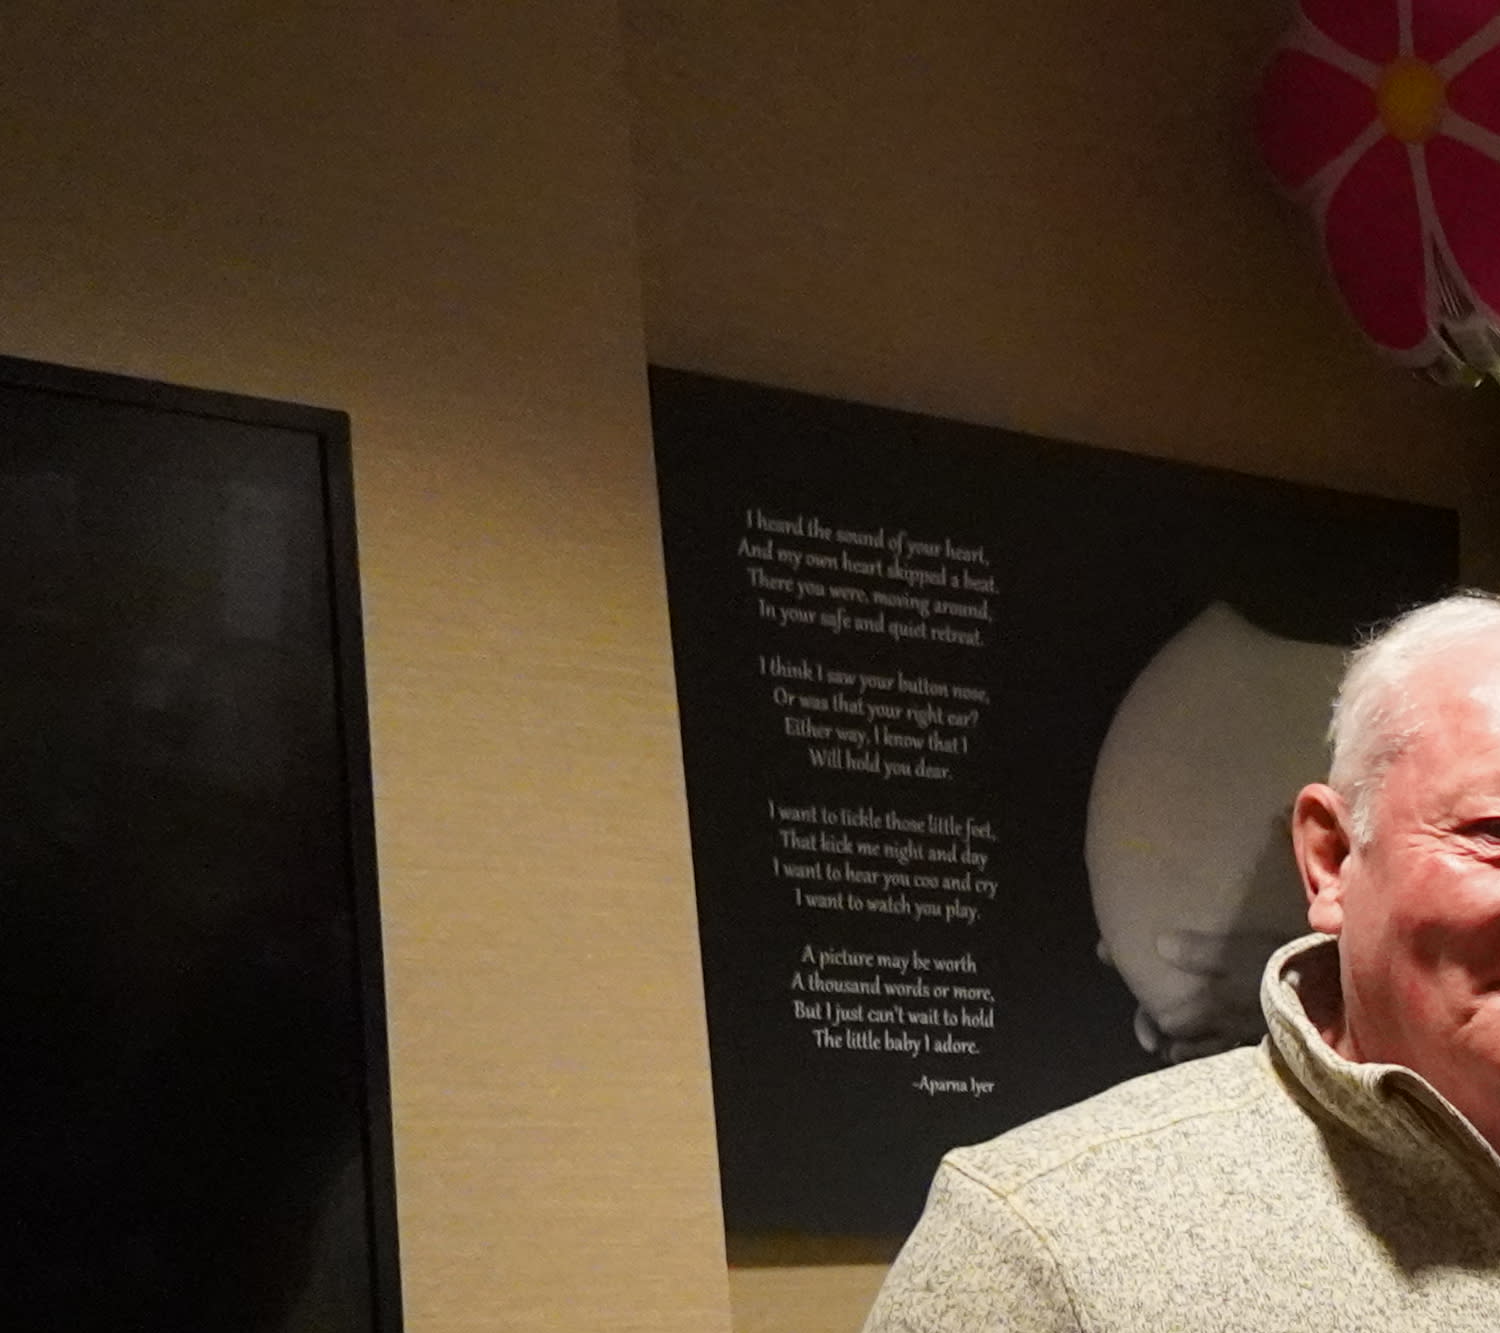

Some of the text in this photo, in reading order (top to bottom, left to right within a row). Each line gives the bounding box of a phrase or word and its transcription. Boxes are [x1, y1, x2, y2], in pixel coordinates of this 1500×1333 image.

[773, 687, 978, 728] Or was that your right ear?
[785, 717, 832, 738] Either
[836, 728, 870, 749] way,
[884, 725, 924, 749] know
[929, 730, 958, 752] that
[808, 749, 953, 779] Will hold you dear.
[778, 807, 816, 823] want
[822, 807, 837, 825] to
[841, 808, 882, 829] tickle
[886, 811, 925, 832] those
[928, 814, 962, 836] little
[966, 818, 999, 842] feet,
[779, 829, 817, 848] That
[820, 832, 852, 853] kick
[857, 843, 880, 856] me
[884, 839, 923, 865] night
[928, 844, 957, 863] and
[783, 861, 821, 880] want
[826, 863, 841, 881] to
[845, 861, 878, 884] hear
[883, 873, 910, 891] you
[914, 875, 939, 888] coo
[943, 872, 970, 891] and
[975, 879, 998, 899] cry
[804, 892, 843, 909] want
[848, 895, 863, 911] to
[866, 894, 911, 913] watch
[915, 904, 941, 921] you
[945, 899, 981, 924] play.
[820, 949, 873, 969] picture
[877, 955, 910, 975] may
[913, 950, 930, 970] be
[934, 953, 976, 973] worth
[808, 970, 880, 994] thousand
[884, 977, 929, 997] words
[933, 986, 950, 998] or
[953, 986, 995, 1002] more,
[794, 1001, 821, 1019] But
[832, 1004, 864, 1026] just
[868, 1006, 904, 1023] can't
[908, 1008, 939, 1025] wait
[943, 1007, 958, 1025] to
[962, 1007, 994, 1028] hold
[812, 1028, 843, 1048] The
[847, 1028, 881, 1049] little
[885, 1030, 921, 1058] baby
[934, 1034, 979, 1054] adore.
[971, 1077, 994, 1097] Iyer
